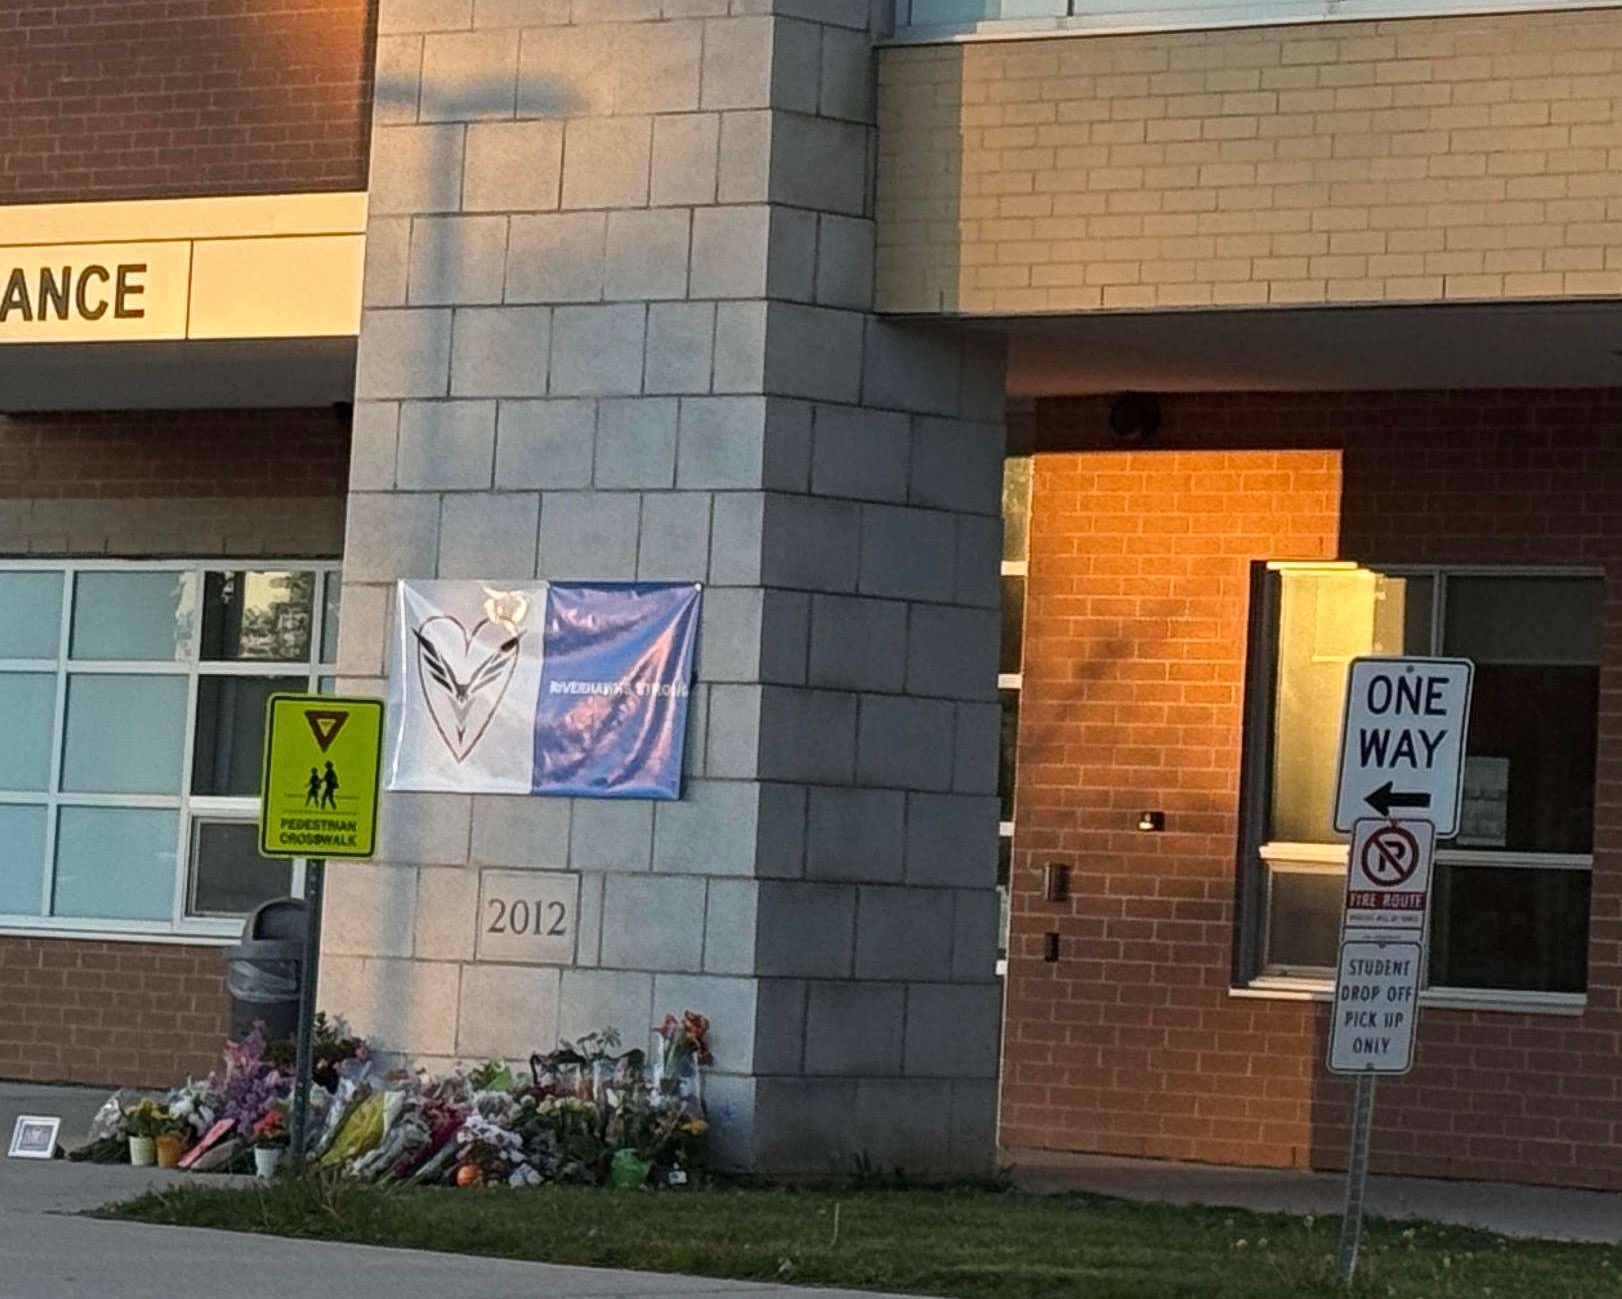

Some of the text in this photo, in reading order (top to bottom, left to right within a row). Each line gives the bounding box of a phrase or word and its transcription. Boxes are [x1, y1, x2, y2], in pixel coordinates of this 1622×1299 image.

[0, 263, 147, 322] ANCE
[1367, 674, 1450, 716] ONE
[1360, 728, 1448, 769] WAY
[280, 817, 357, 832] PEDESTRIAN
[280, 832, 357, 847] CROSSWALK
[1349, 892, 1423, 908] FIRE ROUTE
[487, 898, 567, 936] 2012
[1349, 958, 1411, 977] STUDENT
[1341, 985, 1412, 1002] DROP OFF
[1344, 1011, 1404, 1028] PICK UP
[1352, 1037, 1391, 1054] ONLY
